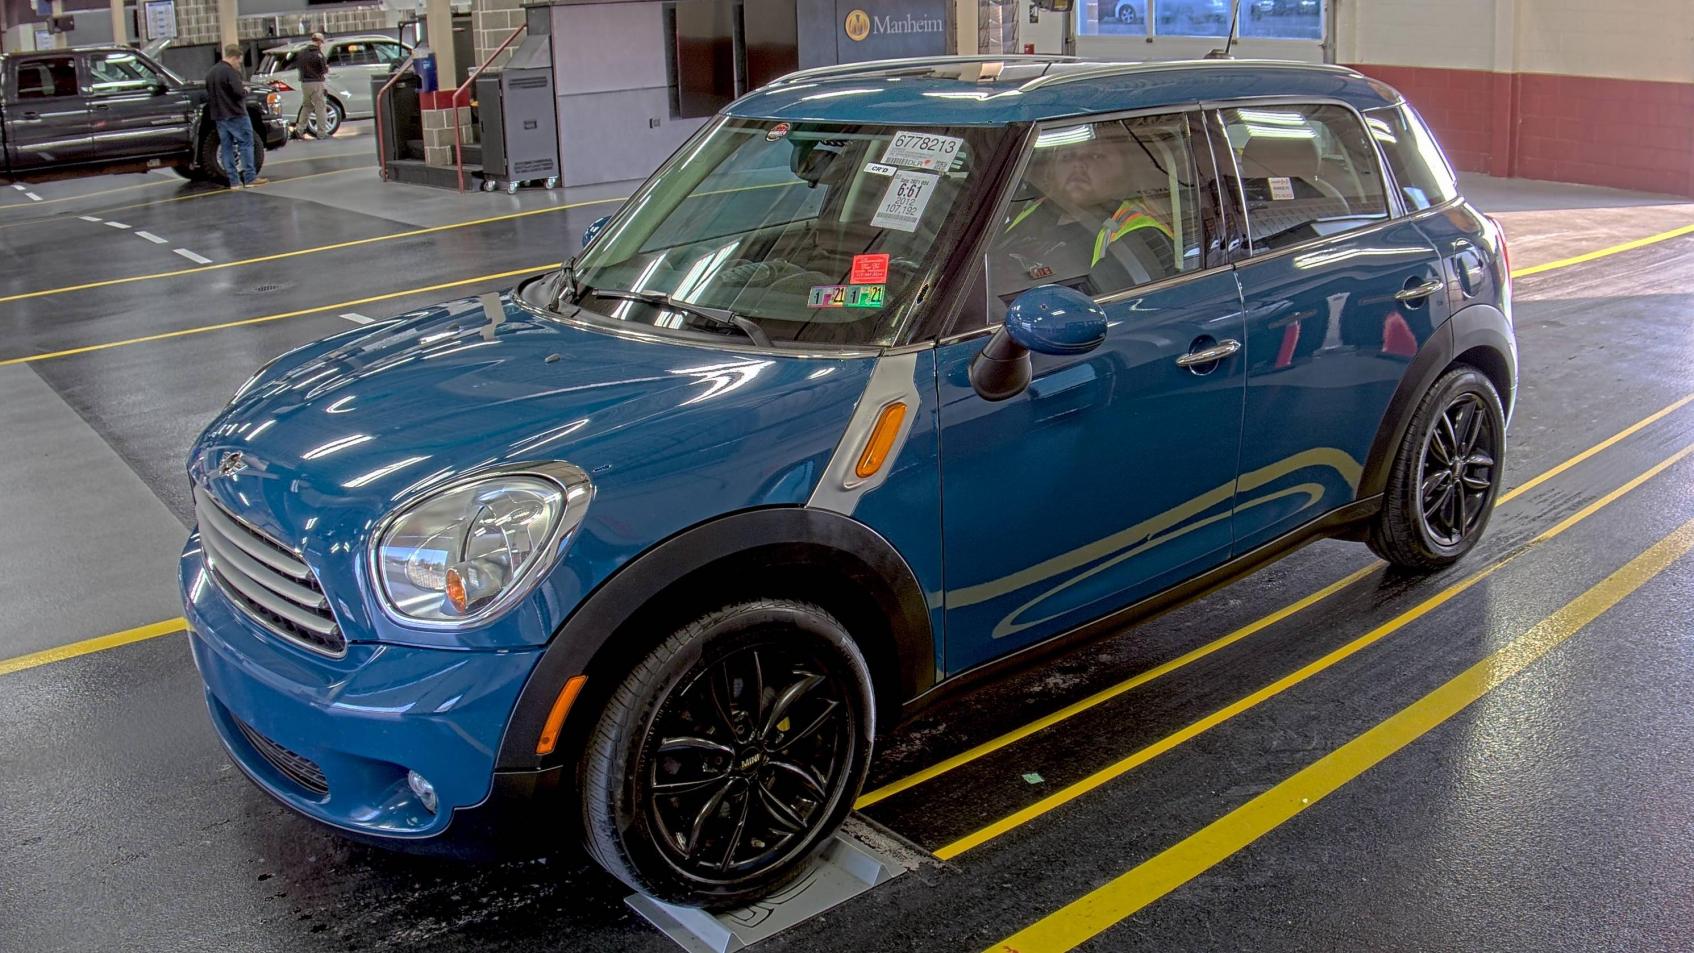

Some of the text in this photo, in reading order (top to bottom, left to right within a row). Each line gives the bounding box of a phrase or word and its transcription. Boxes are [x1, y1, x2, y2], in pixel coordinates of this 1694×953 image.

[873, 13, 944, 34] Manheim
[895, 134, 957, 154] 6778213
[897, 183, 922, 198] 6:61
[895, 197, 916, 206] 2012
[740, 753, 760, 768] MINI
